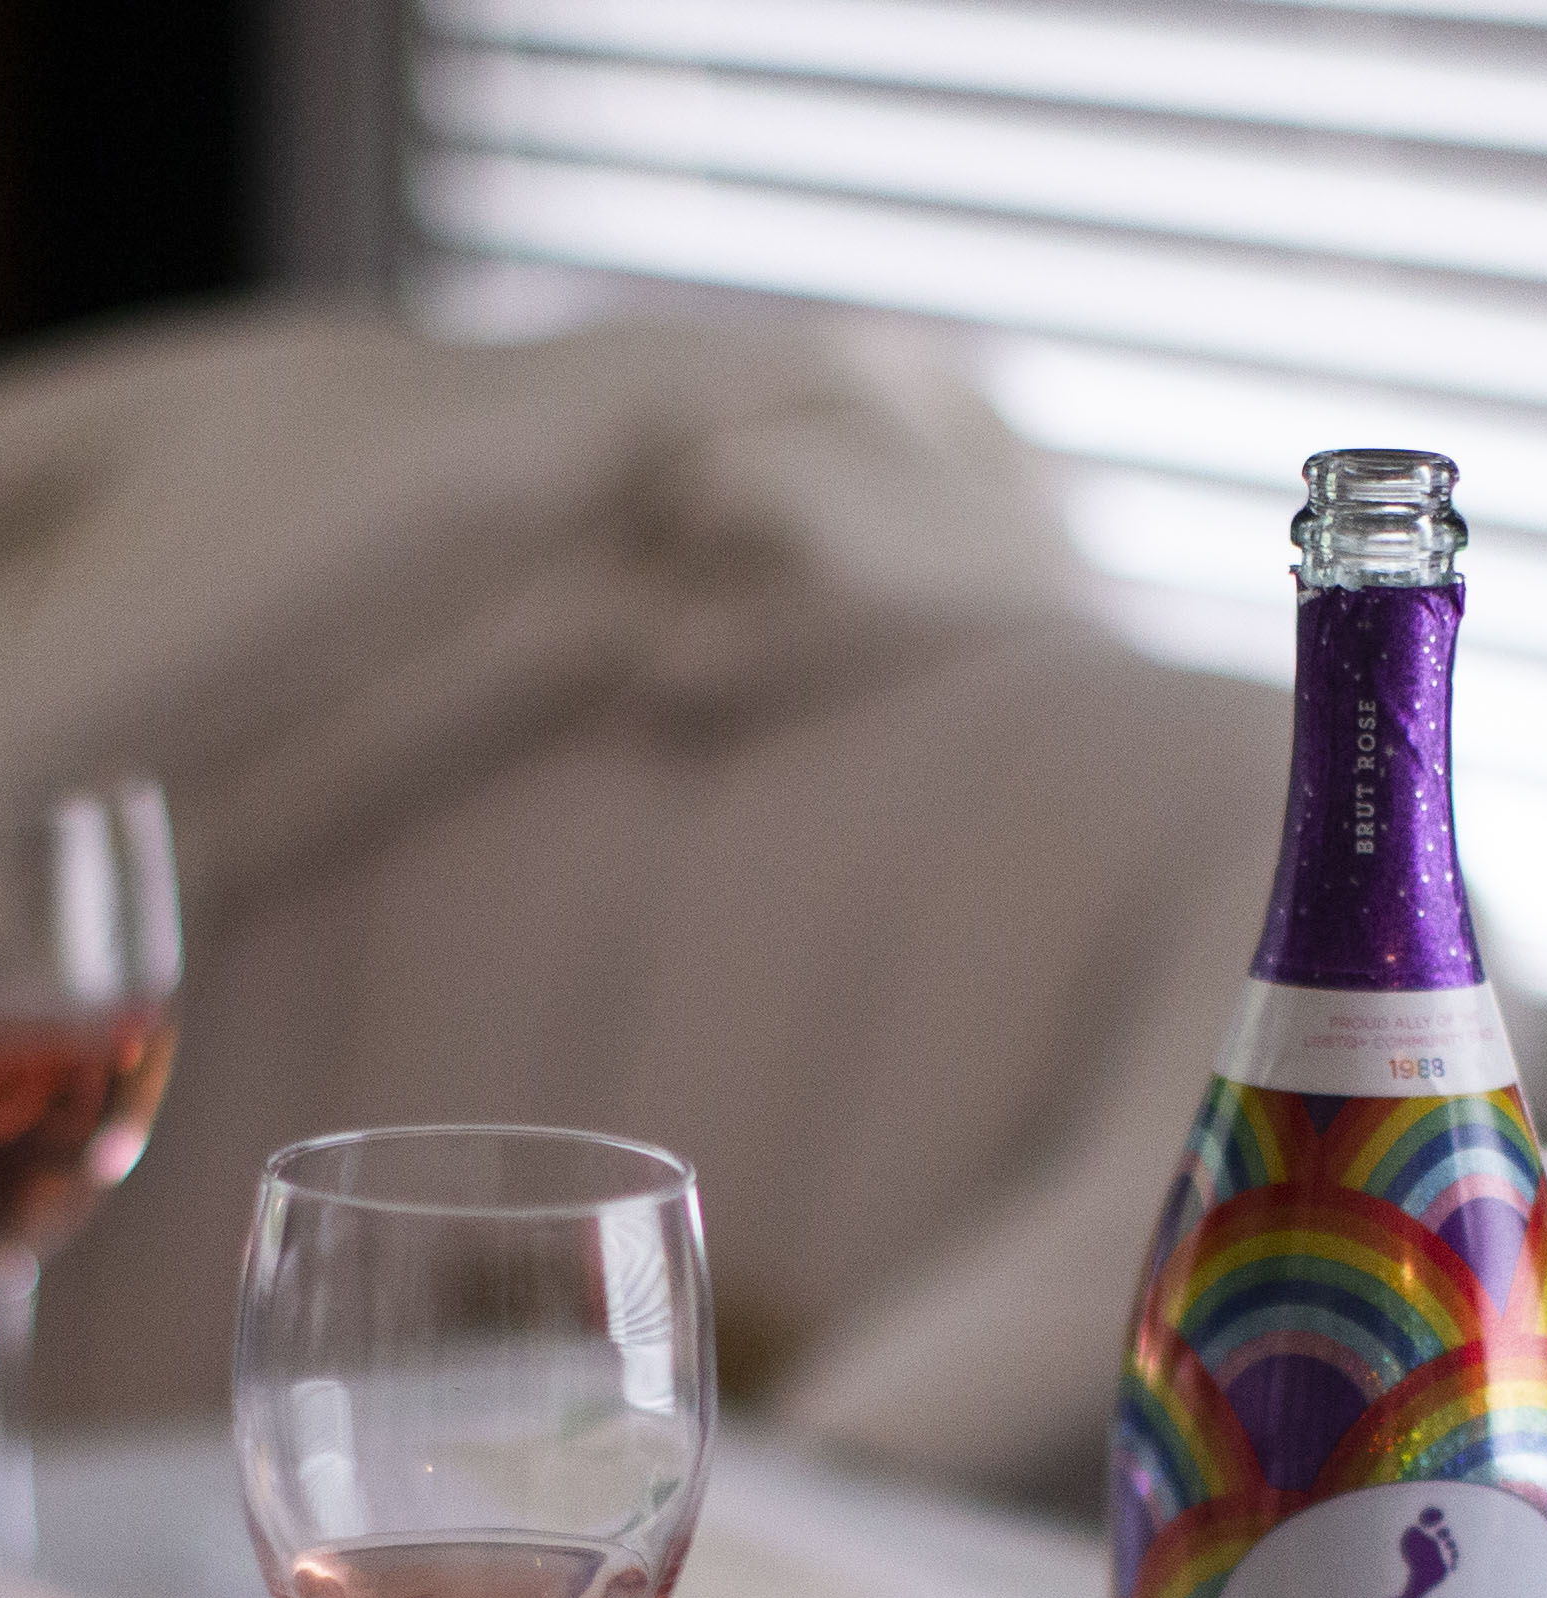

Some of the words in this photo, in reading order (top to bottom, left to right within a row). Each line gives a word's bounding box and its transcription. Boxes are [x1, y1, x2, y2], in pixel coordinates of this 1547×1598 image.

[1357, 700, 1376, 770] ROSE
[1356, 783, 1375, 855] BRUT
[1389, 1057, 1446, 1080] 1988
